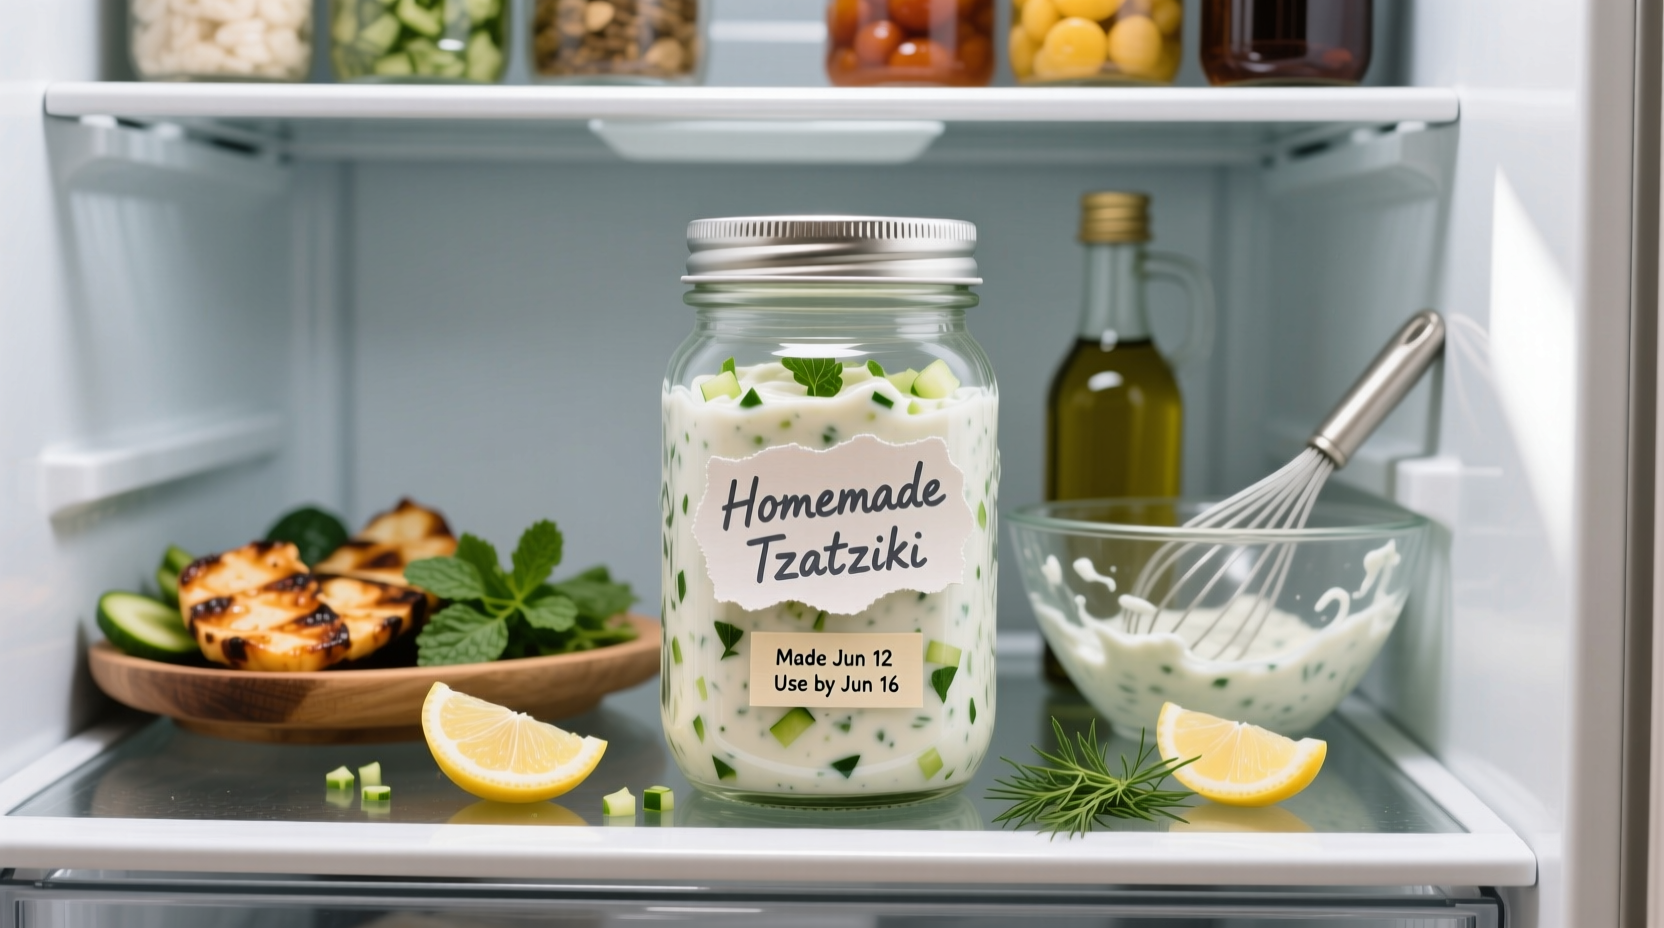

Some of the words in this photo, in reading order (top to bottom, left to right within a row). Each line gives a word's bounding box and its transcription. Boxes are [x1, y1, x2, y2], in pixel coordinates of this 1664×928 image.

[722, 461, 946, 531] Homemade
[747, 526, 927, 583] Tzatziki
[776, 648, 826, 666] Made
[833, 649, 865, 666] Jun
[873, 649, 892, 667] 12
[775, 674, 807, 691] Use
[815, 674, 835, 697] by
[841, 675, 872, 692] Jun
[880, 675, 899, 692] 16
